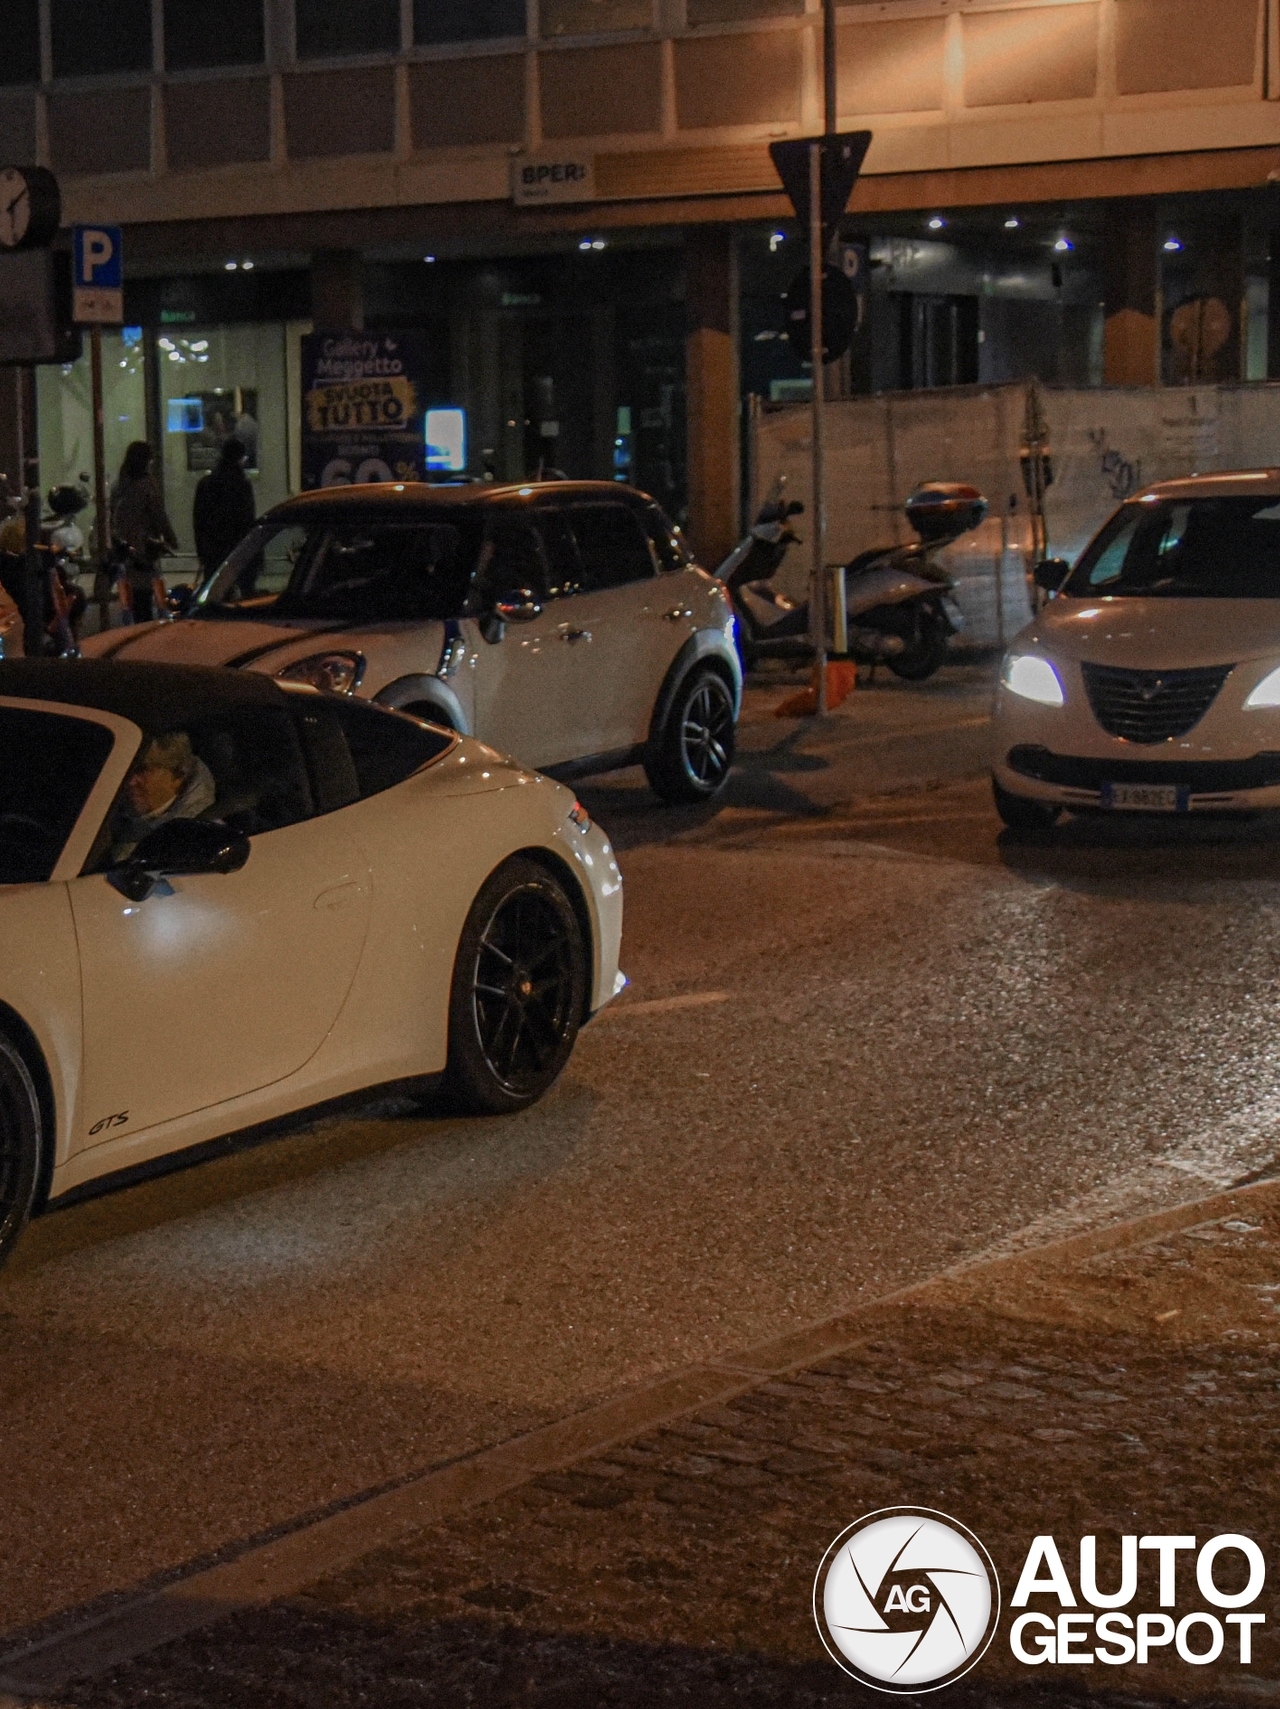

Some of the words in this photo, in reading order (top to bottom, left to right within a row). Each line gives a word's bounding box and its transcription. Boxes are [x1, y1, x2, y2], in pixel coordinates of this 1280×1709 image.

[83, 229, 114, 282] P
[317, 397, 403, 426] TUTTO
[88, 1109, 129, 1135] GTS
